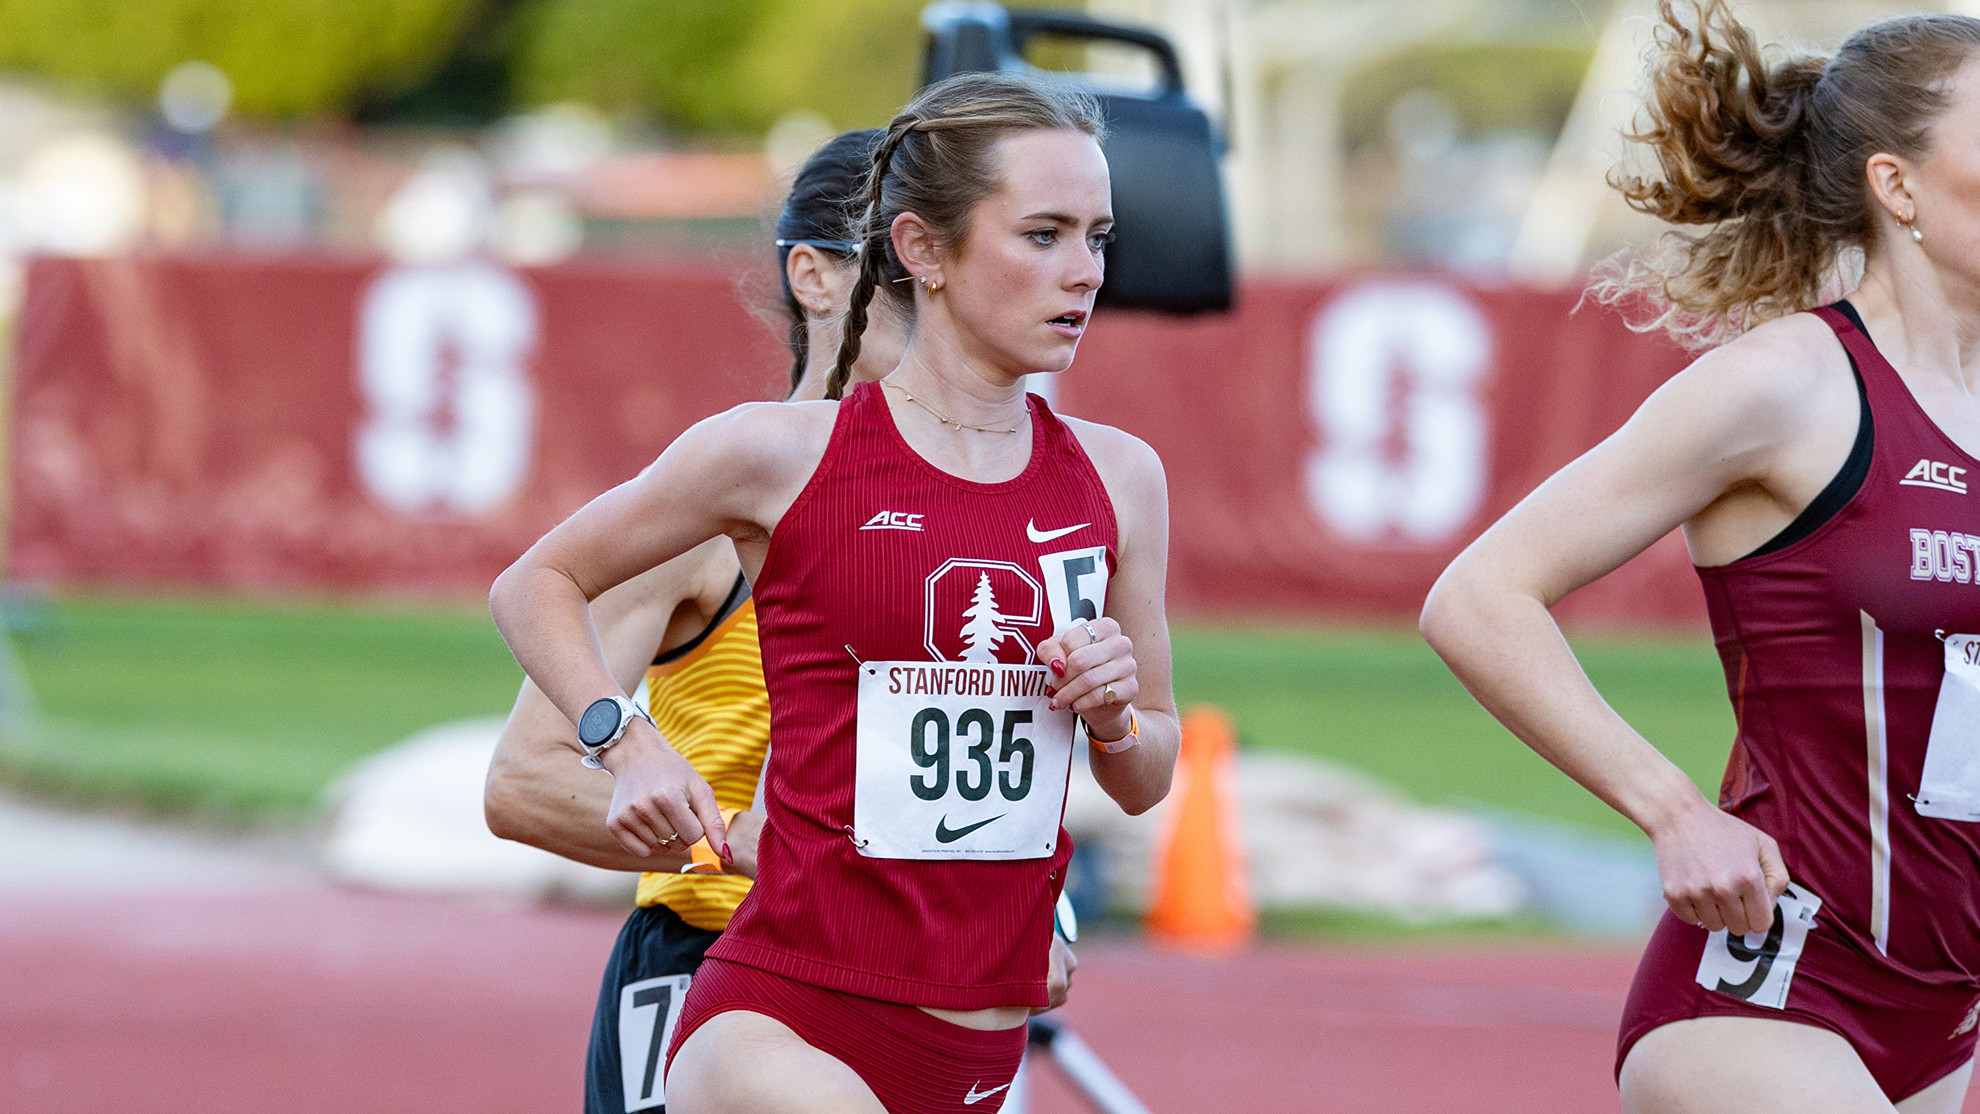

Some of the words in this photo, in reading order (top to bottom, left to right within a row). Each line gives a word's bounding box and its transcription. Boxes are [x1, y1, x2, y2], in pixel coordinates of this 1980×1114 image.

[1901, 459, 1967, 492] ACC
[860, 510, 925, 530] ACC
[1963, 640, 1980, 666] ST
[888, 667, 995, 696] STANFORD
[1000, 670, 1049, 697] INVIT
[909, 707, 1036, 802] 935
[632, 984, 672, 1100] 7
